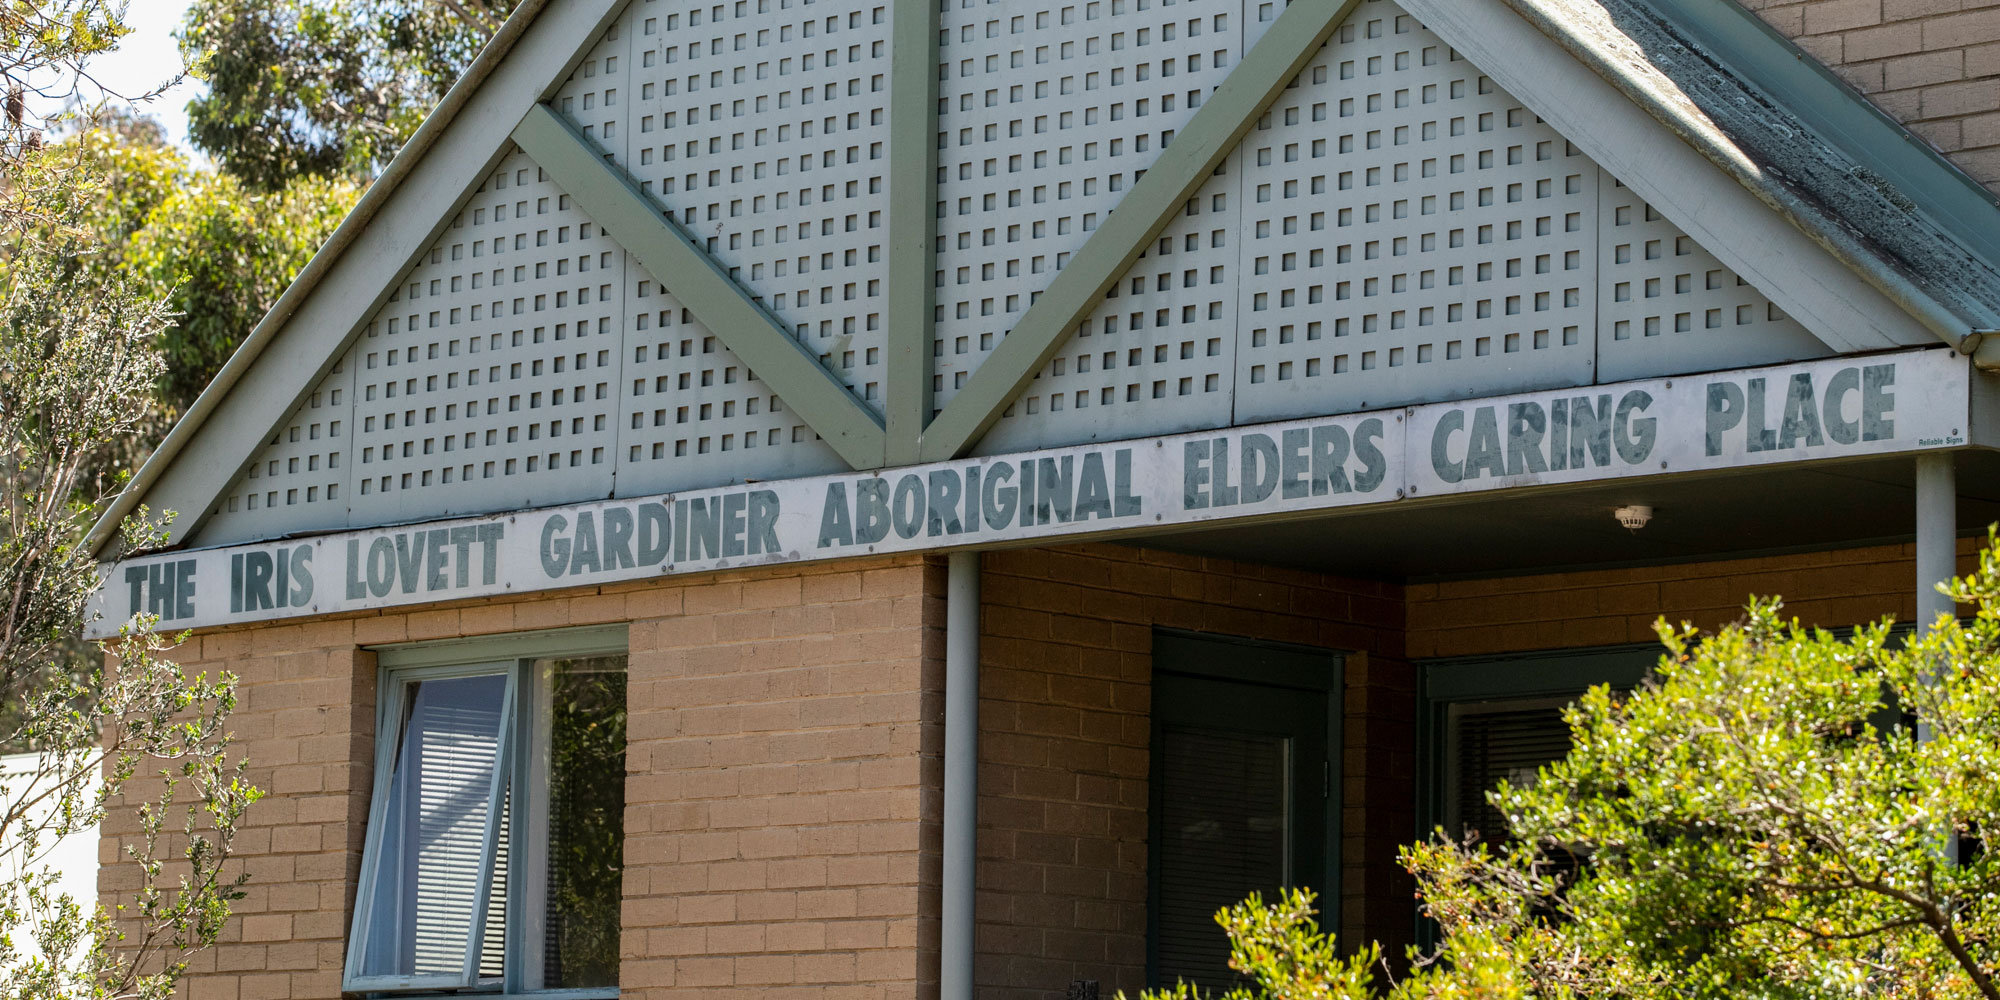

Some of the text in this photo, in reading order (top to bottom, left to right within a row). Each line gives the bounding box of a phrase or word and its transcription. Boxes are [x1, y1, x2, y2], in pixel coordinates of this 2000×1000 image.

[125, 363, 1895, 621] THE IRIS LOVETT GARDINER ABORIGINAL ELDERS CARING PLACE
[1919, 437, 1963, 446] Reliable Signs
